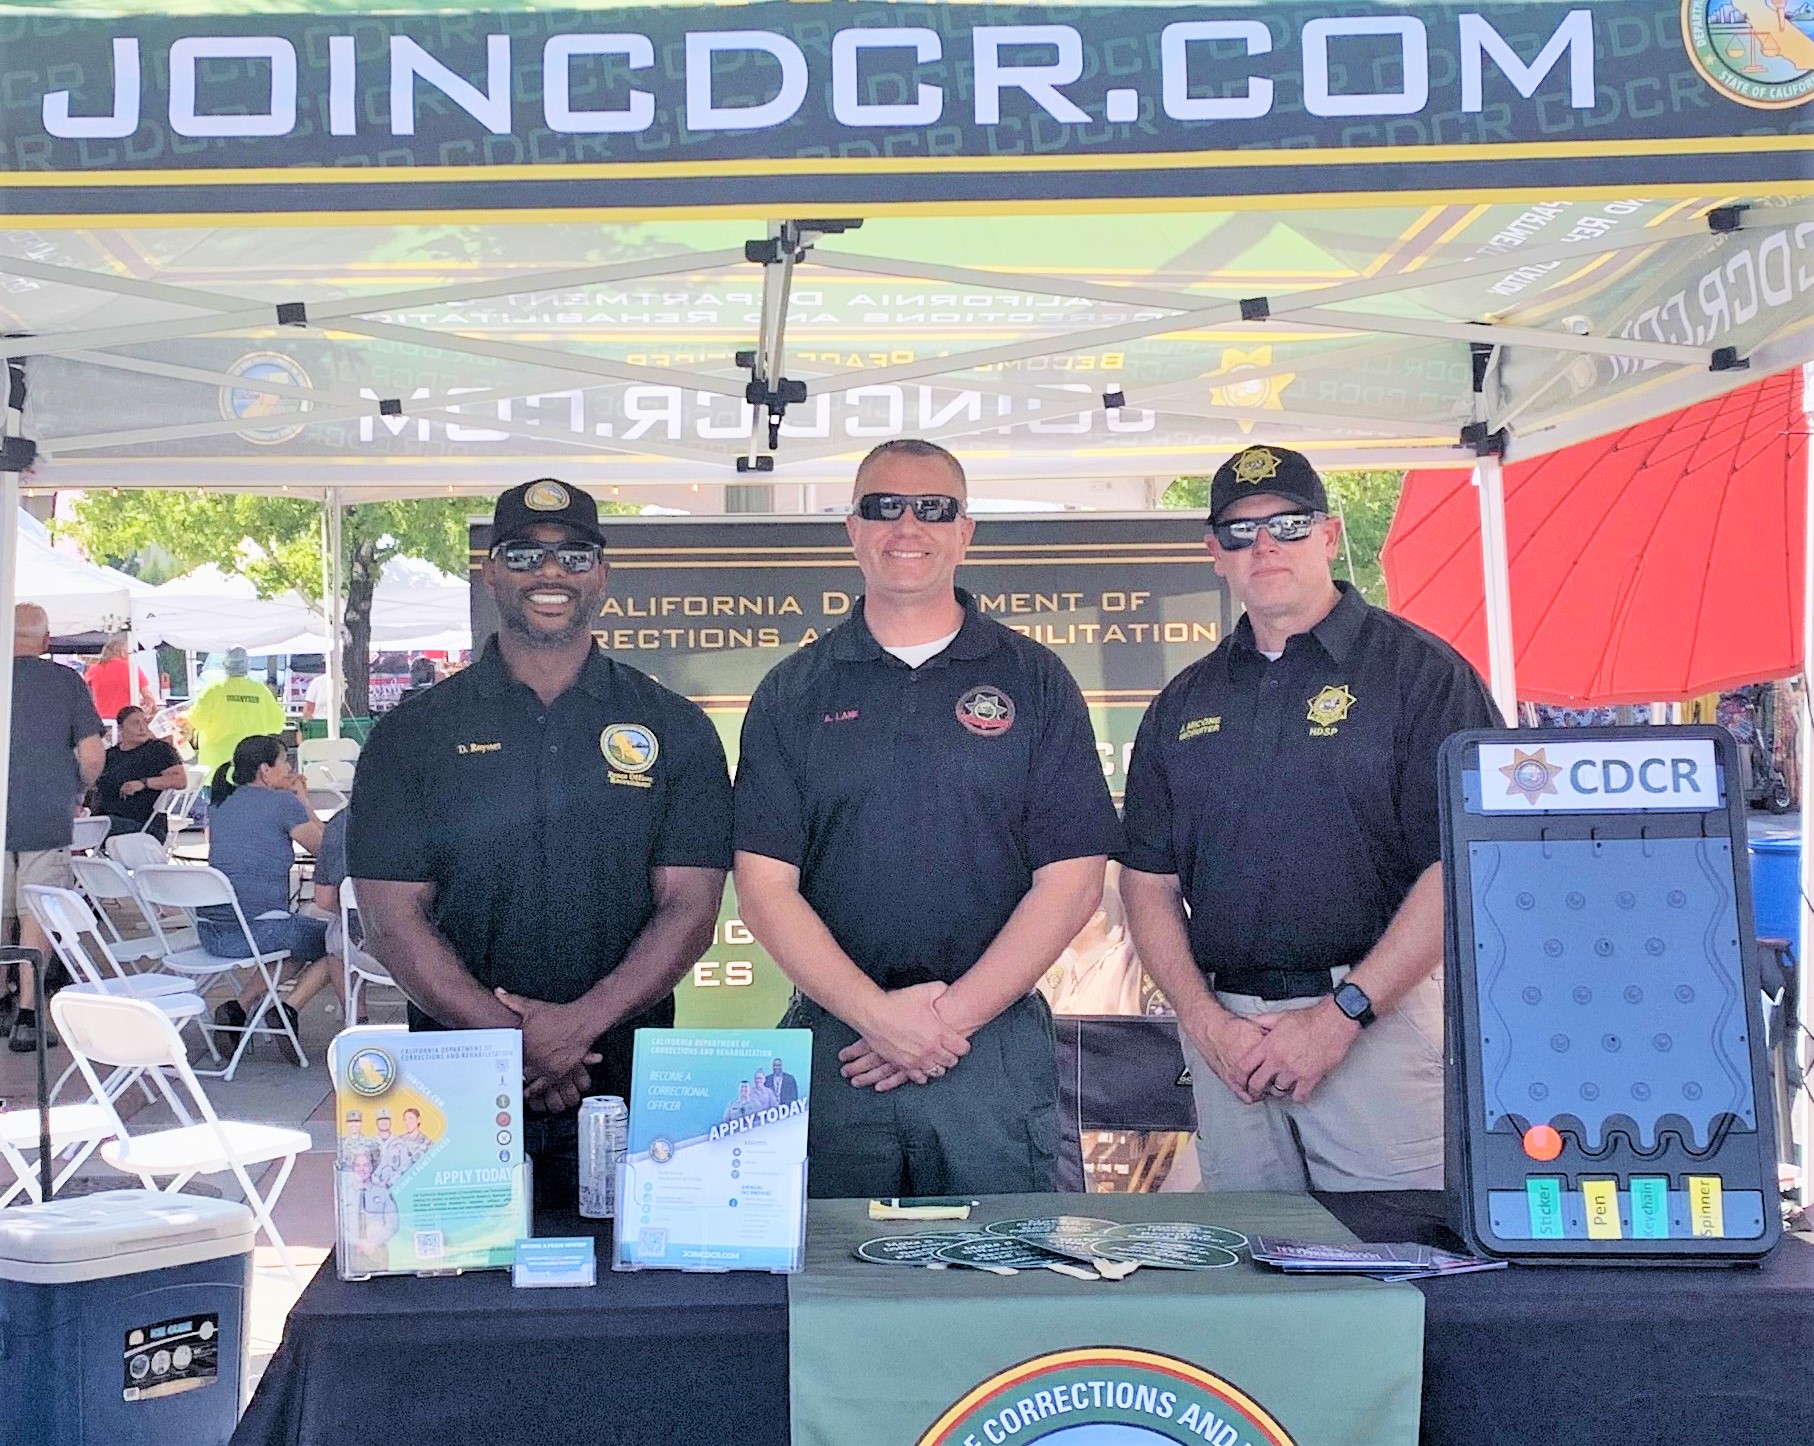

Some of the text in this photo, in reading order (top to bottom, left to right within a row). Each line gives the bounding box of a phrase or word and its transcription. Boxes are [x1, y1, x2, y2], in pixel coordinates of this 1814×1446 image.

[42, 10, 1596, 138] JOINCDCR.COM
[1719, 70, 1750, 94] STATE
[1752, 87, 1767, 97] OF
[599, 595, 803, 618] ALIFORNIA
[1101, 591, 1150, 613] OF
[591, 627, 781, 650] RECTIONS
[1309, 727, 1339, 737] HDSP
[1569, 758, 1702, 794] CDCR
[648, 1070, 686, 1081] BECOME
[648, 1085, 710, 1097] CORRECTIONAL
[646, 1100, 681, 1112] OFFICER
[709, 1096, 808, 1142] APPLY TODAY
[434, 1166, 513, 1186] APPLY TODAY
[1539, 1184, 1553, 1235] Sticker
[1593, 1195, 1609, 1226] Pen
[1640, 1181, 1658, 1239] Keychain
[1700, 1179, 1714, 1239] Spinner
[982, 1380, 1239, 1446] CORRECTIONS AND
